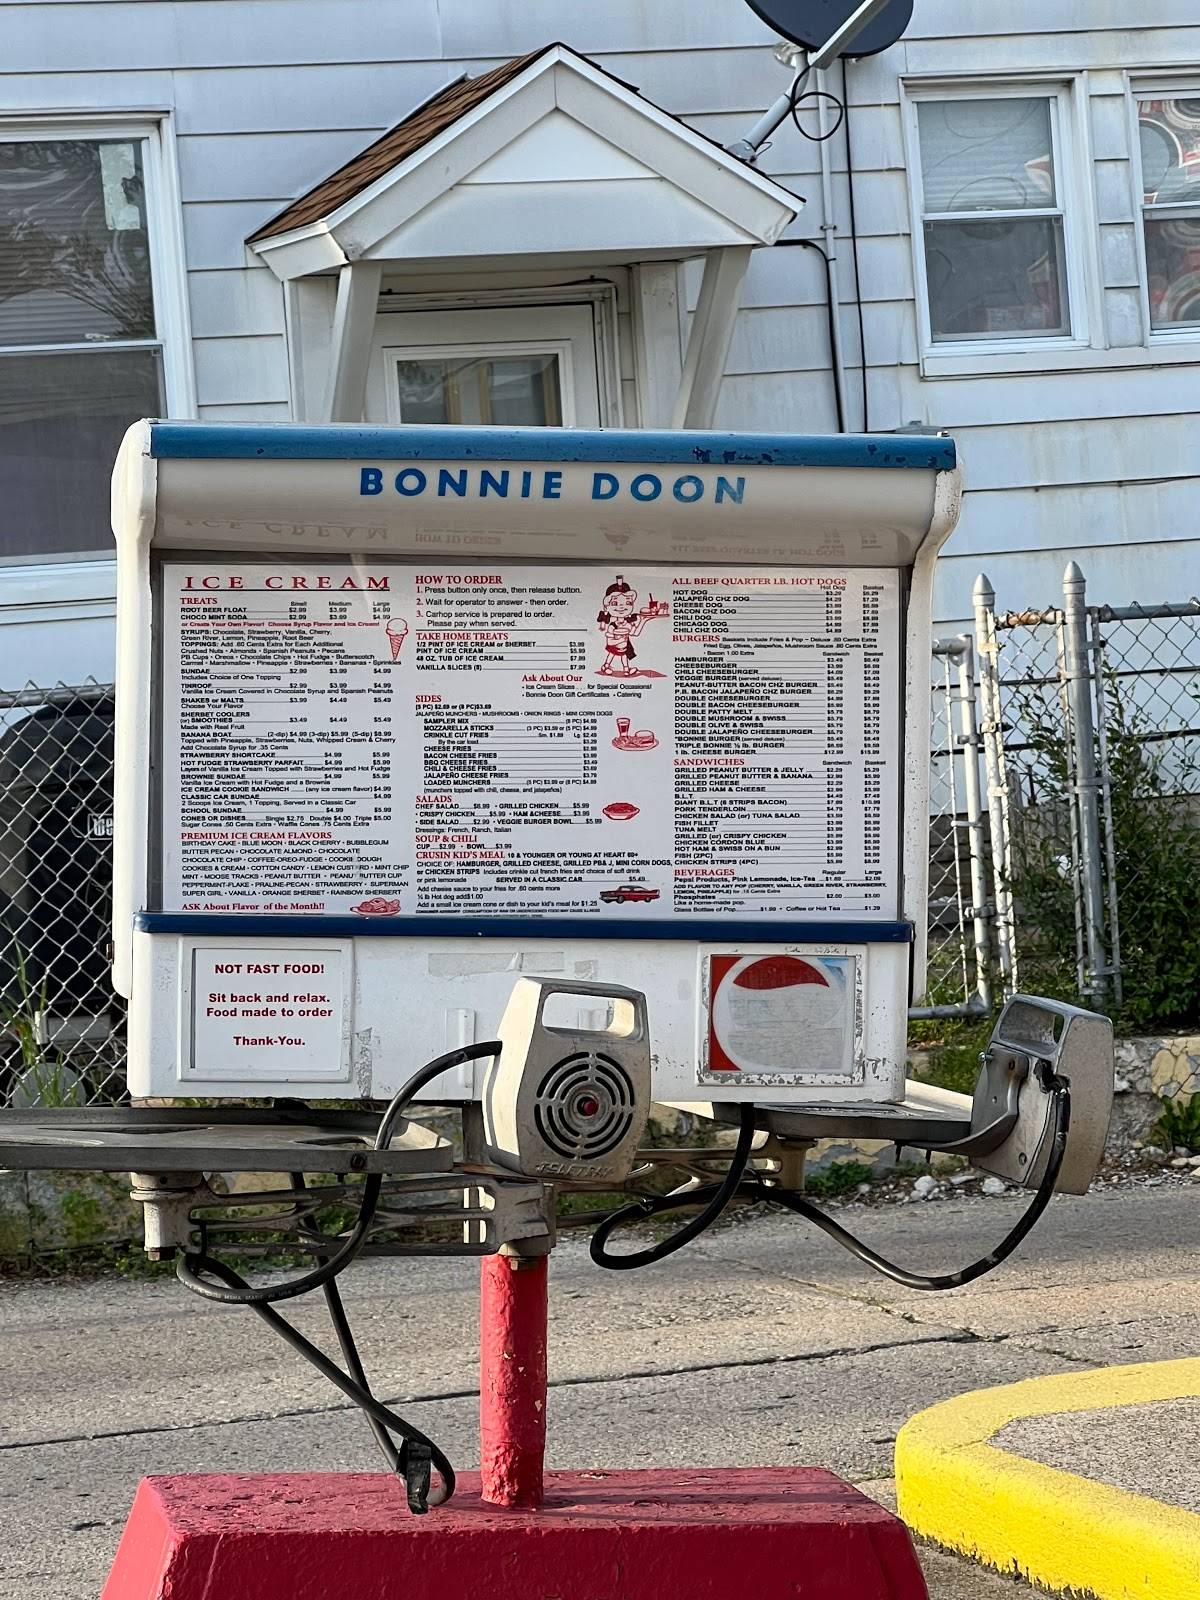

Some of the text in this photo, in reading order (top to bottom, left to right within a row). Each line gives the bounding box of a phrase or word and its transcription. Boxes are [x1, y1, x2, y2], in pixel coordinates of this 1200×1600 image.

[360, 467, 747, 505] BONNIE DOON
[185, 576, 389, 589] ICE CREAM
[416, 576, 502, 584] HOW TO ORDER
[215, 964, 324, 973] NOT FAST FOOD!
[209, 993, 330, 1002] Sit back and relax.
[207, 1008, 333, 1017] Food made to order
[233, 1036, 305, 1045] Thank-You.
